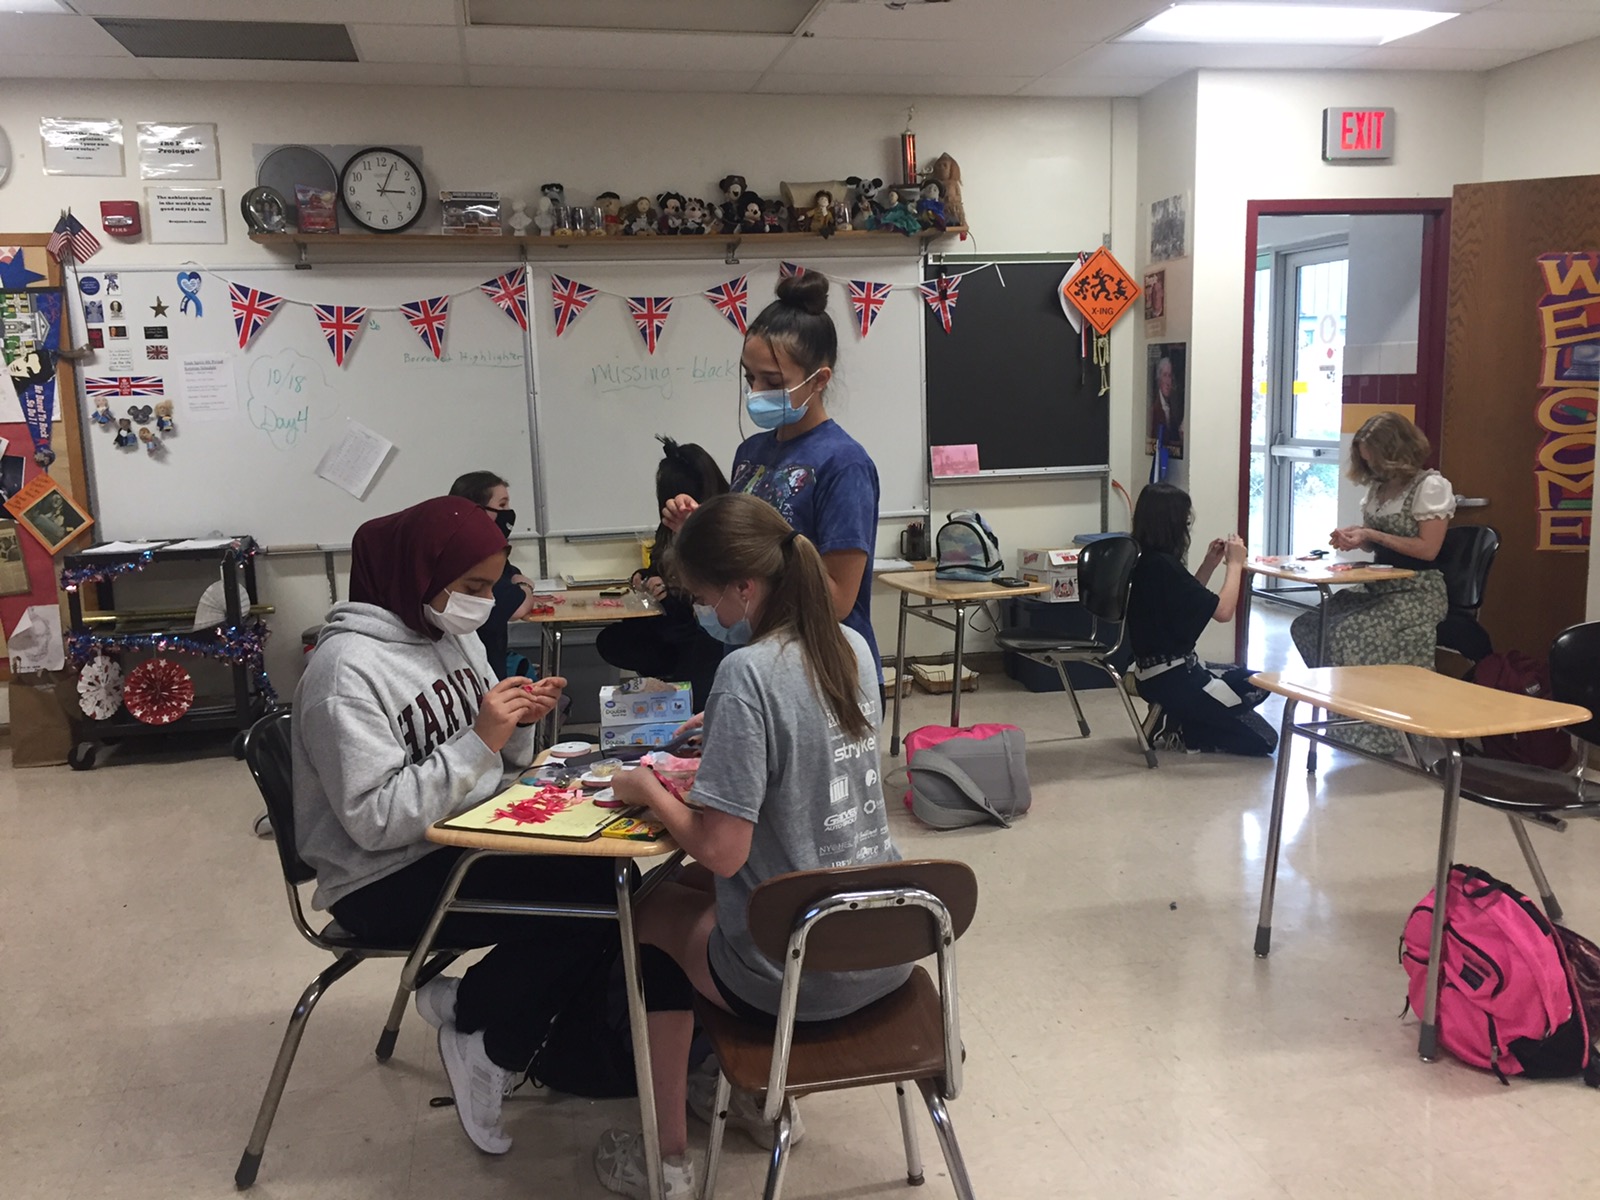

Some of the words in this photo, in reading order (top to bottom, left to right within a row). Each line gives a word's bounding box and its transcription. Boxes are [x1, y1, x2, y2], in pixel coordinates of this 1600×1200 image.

[1340, 111, 1386, 150] EXIT
[362, 160, 372, 170] 11
[376, 157, 387, 167] 12
[394, 162, 398, 171] 1
[352, 172, 362, 182] 10
[404, 170, 410, 181] 2
[349, 186, 356, 196] 9
[410, 186, 416, 196] 3
[355, 200, 362, 210] 8
[406, 201, 412, 211] 4
[366, 211, 372, 221] 7
[382, 215, 388, 225] 6
[397, 211, 404, 221] 5
[1091, 307, 1114, 315] X-ING
[460, 351, 524, 364] Highlighter
[267, 363, 306, 395] 10/18
[592, 363, 674, 400] Missing
[1536, 257, 1600, 551] WELCOME
[397, 667, 490, 764] HARVA
